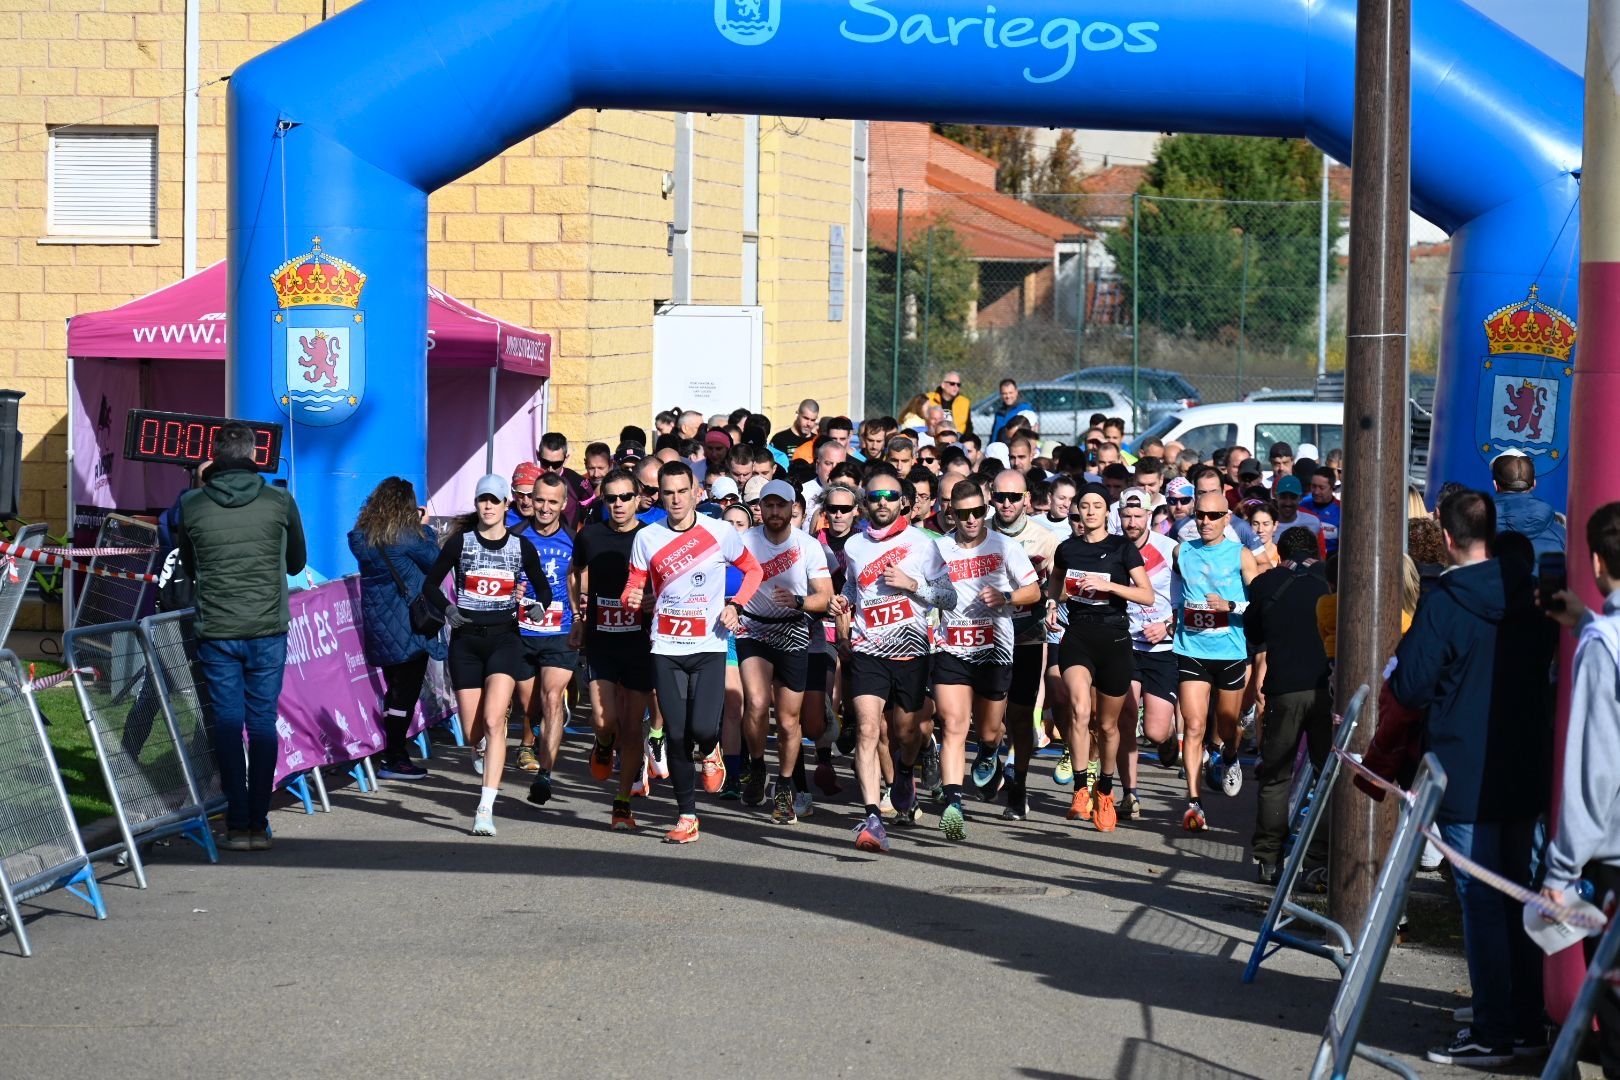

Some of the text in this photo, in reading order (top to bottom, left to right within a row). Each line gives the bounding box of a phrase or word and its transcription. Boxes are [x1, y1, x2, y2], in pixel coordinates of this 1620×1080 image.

[839, 0, 1160, 84] Sariegos
[662, 538, 700, 567] DESPENSA
[670, 554, 696, 575] FER
[862, 549, 902, 578] DESPENSA
[947, 557, 992, 574] DESPENSA
[971, 566, 991, 580] FER
[476, 579, 502, 596] 89
[602, 609, 635, 626] 113
[668, 608, 681, 616] CROSS
[870, 603, 904, 627] 175
[1193, 612, 1216, 628] 83
[669, 618, 693, 636] 72
[953, 629, 986, 646] 155
